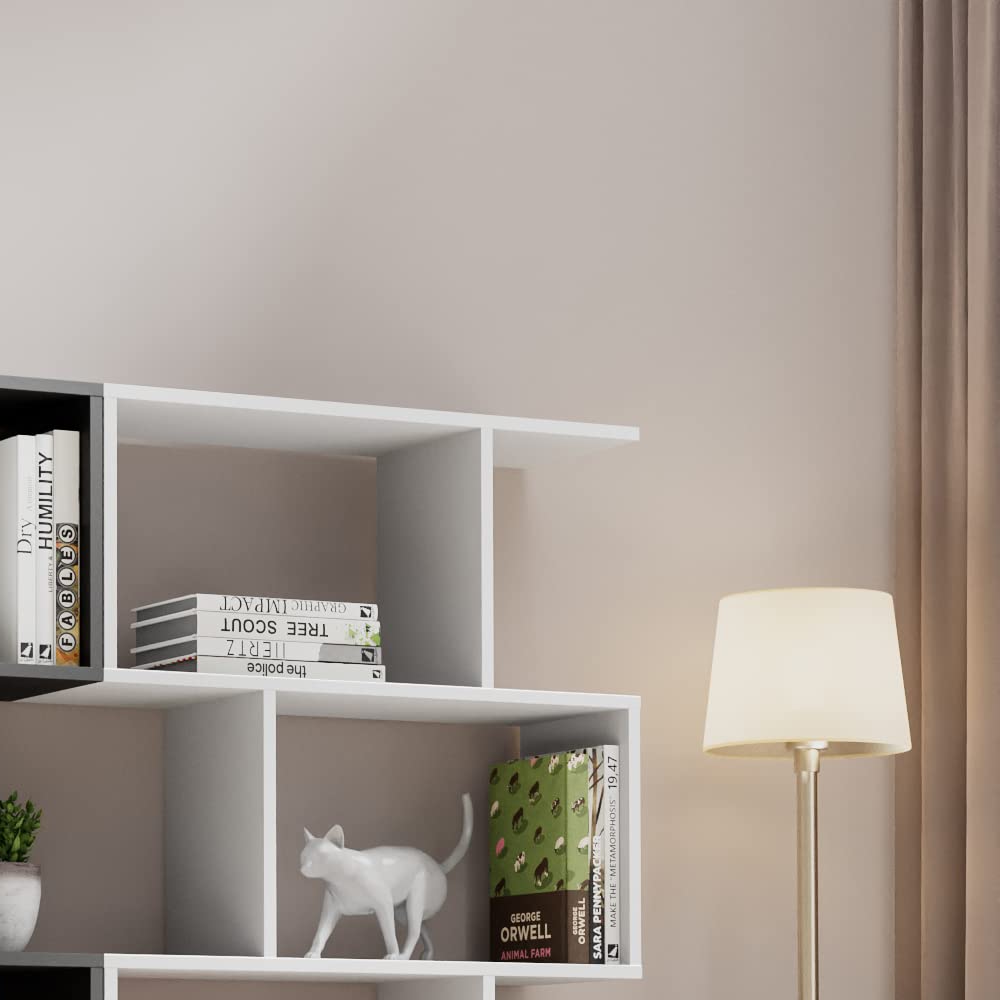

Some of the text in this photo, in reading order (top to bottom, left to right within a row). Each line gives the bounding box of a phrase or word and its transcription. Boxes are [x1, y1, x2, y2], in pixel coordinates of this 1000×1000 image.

[38, 452, 53, 550] HUMILITY
[17, 518, 36, 554] Dry
[59, 526, 75, 650] FABLES
[219, 596, 346, 614] GRAPHIC IMPACT
[220, 618, 328, 637] TREE SCOUT
[247, 662, 306, 678] the police
[592, 835, 602, 959] SARA PENNYPACKER
[510, 911, 541, 923] GEORGE
[578, 898, 586, 945] ORWELL
[500, 923, 552, 943] ORWELL
[500, 947, 551, 960] ANIMAL FARM
